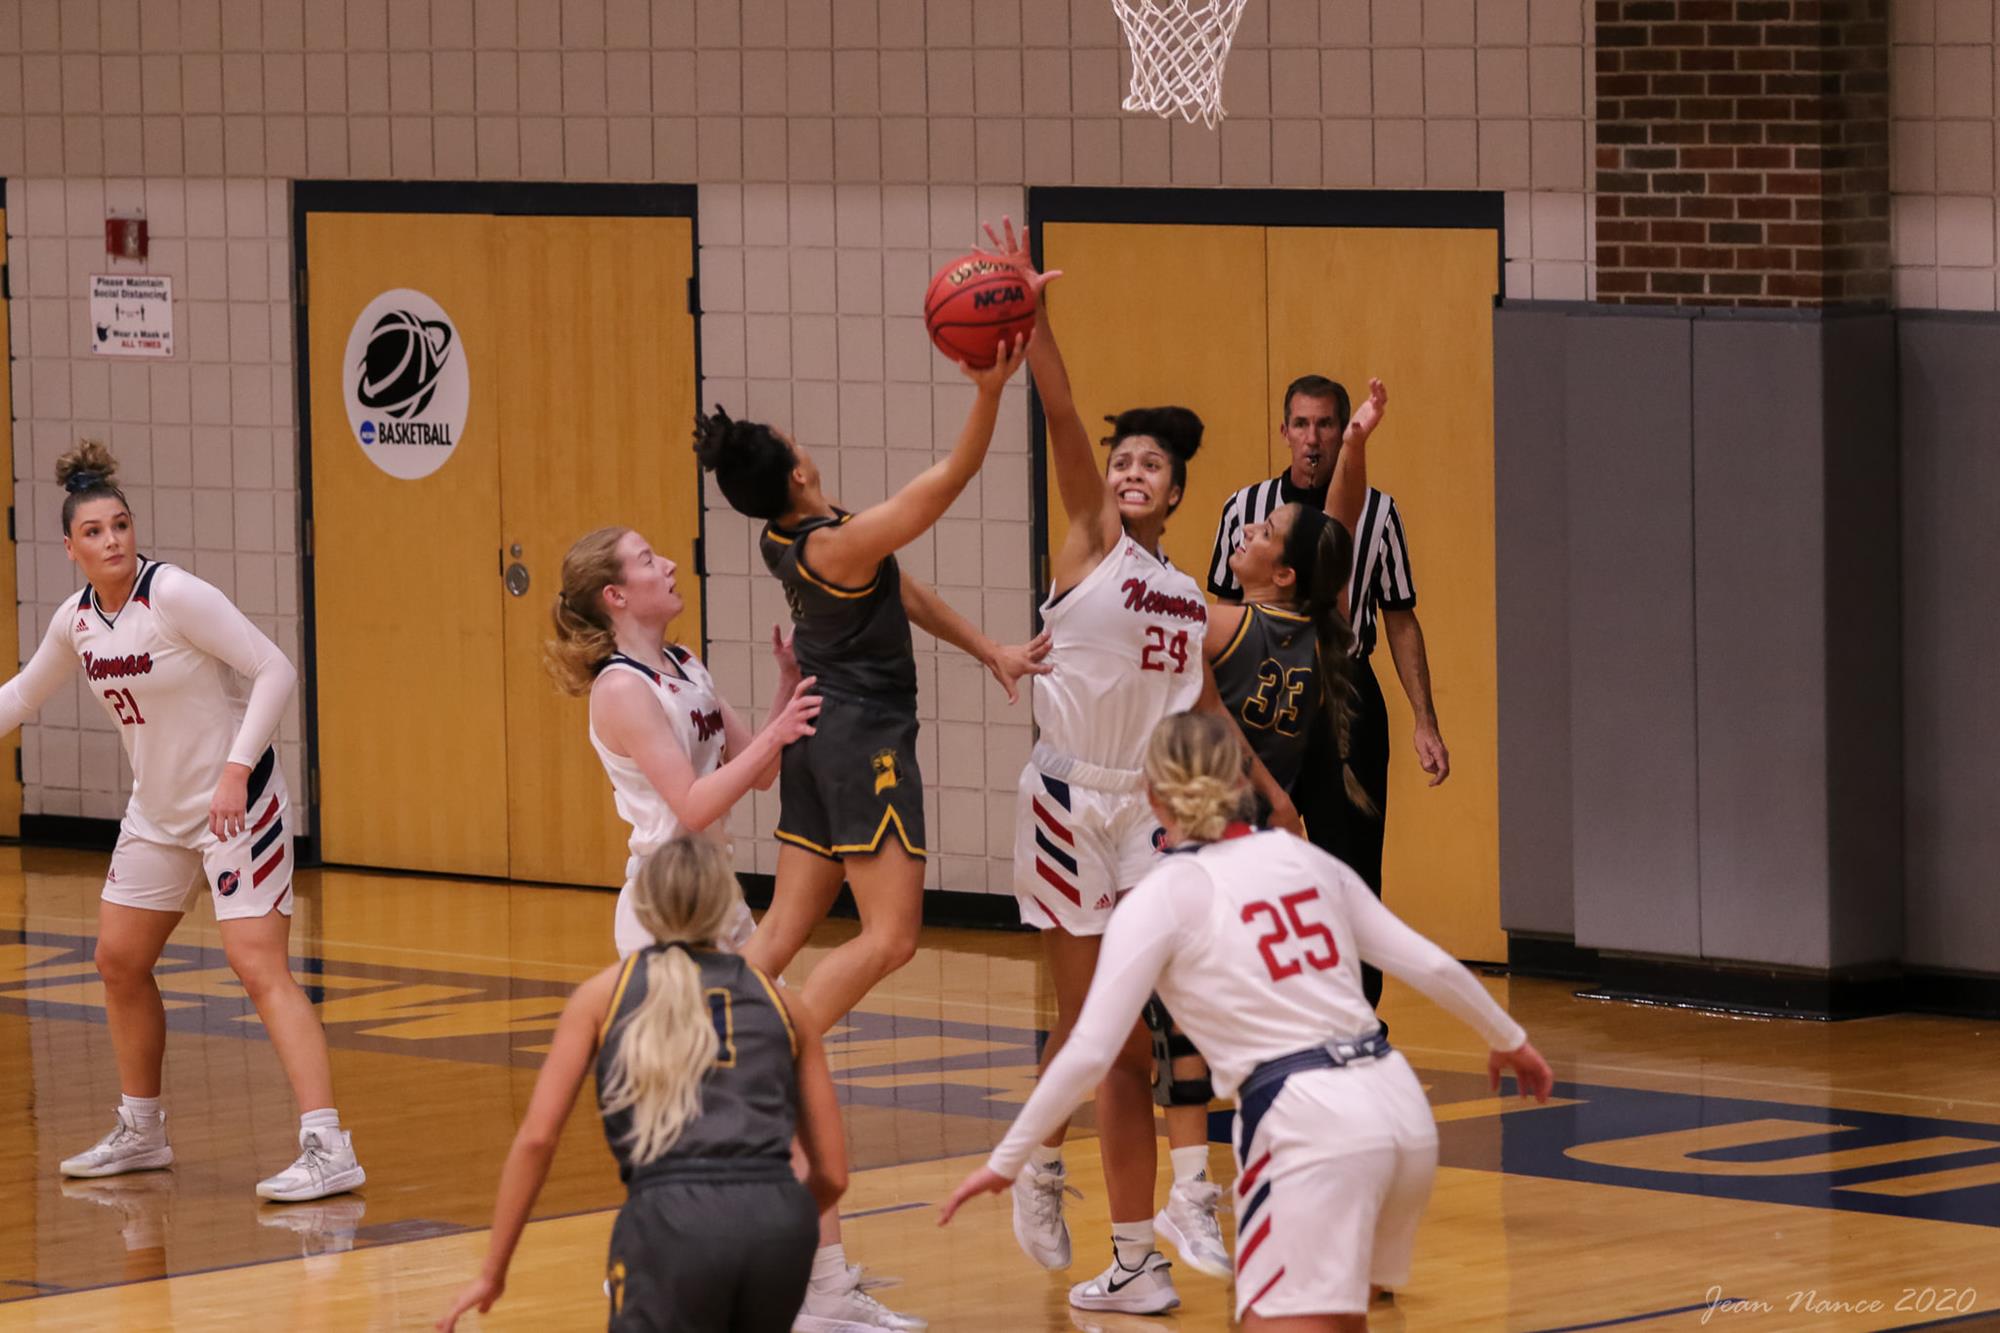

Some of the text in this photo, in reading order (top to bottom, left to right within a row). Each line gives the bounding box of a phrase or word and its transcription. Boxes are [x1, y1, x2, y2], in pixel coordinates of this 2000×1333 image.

[97, 277, 164, 287] Please Maintain
[94, 289, 167, 302] Social Distancing
[974, 286, 1025, 310] NCAA
[112, 330, 131, 338] Wear
[140, 330, 160, 339] Mask
[121, 340, 161, 349] ALL TIMES
[379, 422, 452, 446] BASKETBALL
[1141, 626, 1188, 674] 24
[82, 650, 154, 681] Newman
[103, 687, 146, 725] 21
[1241, 657, 1313, 738] 33
[1240, 886, 1340, 983] 25
